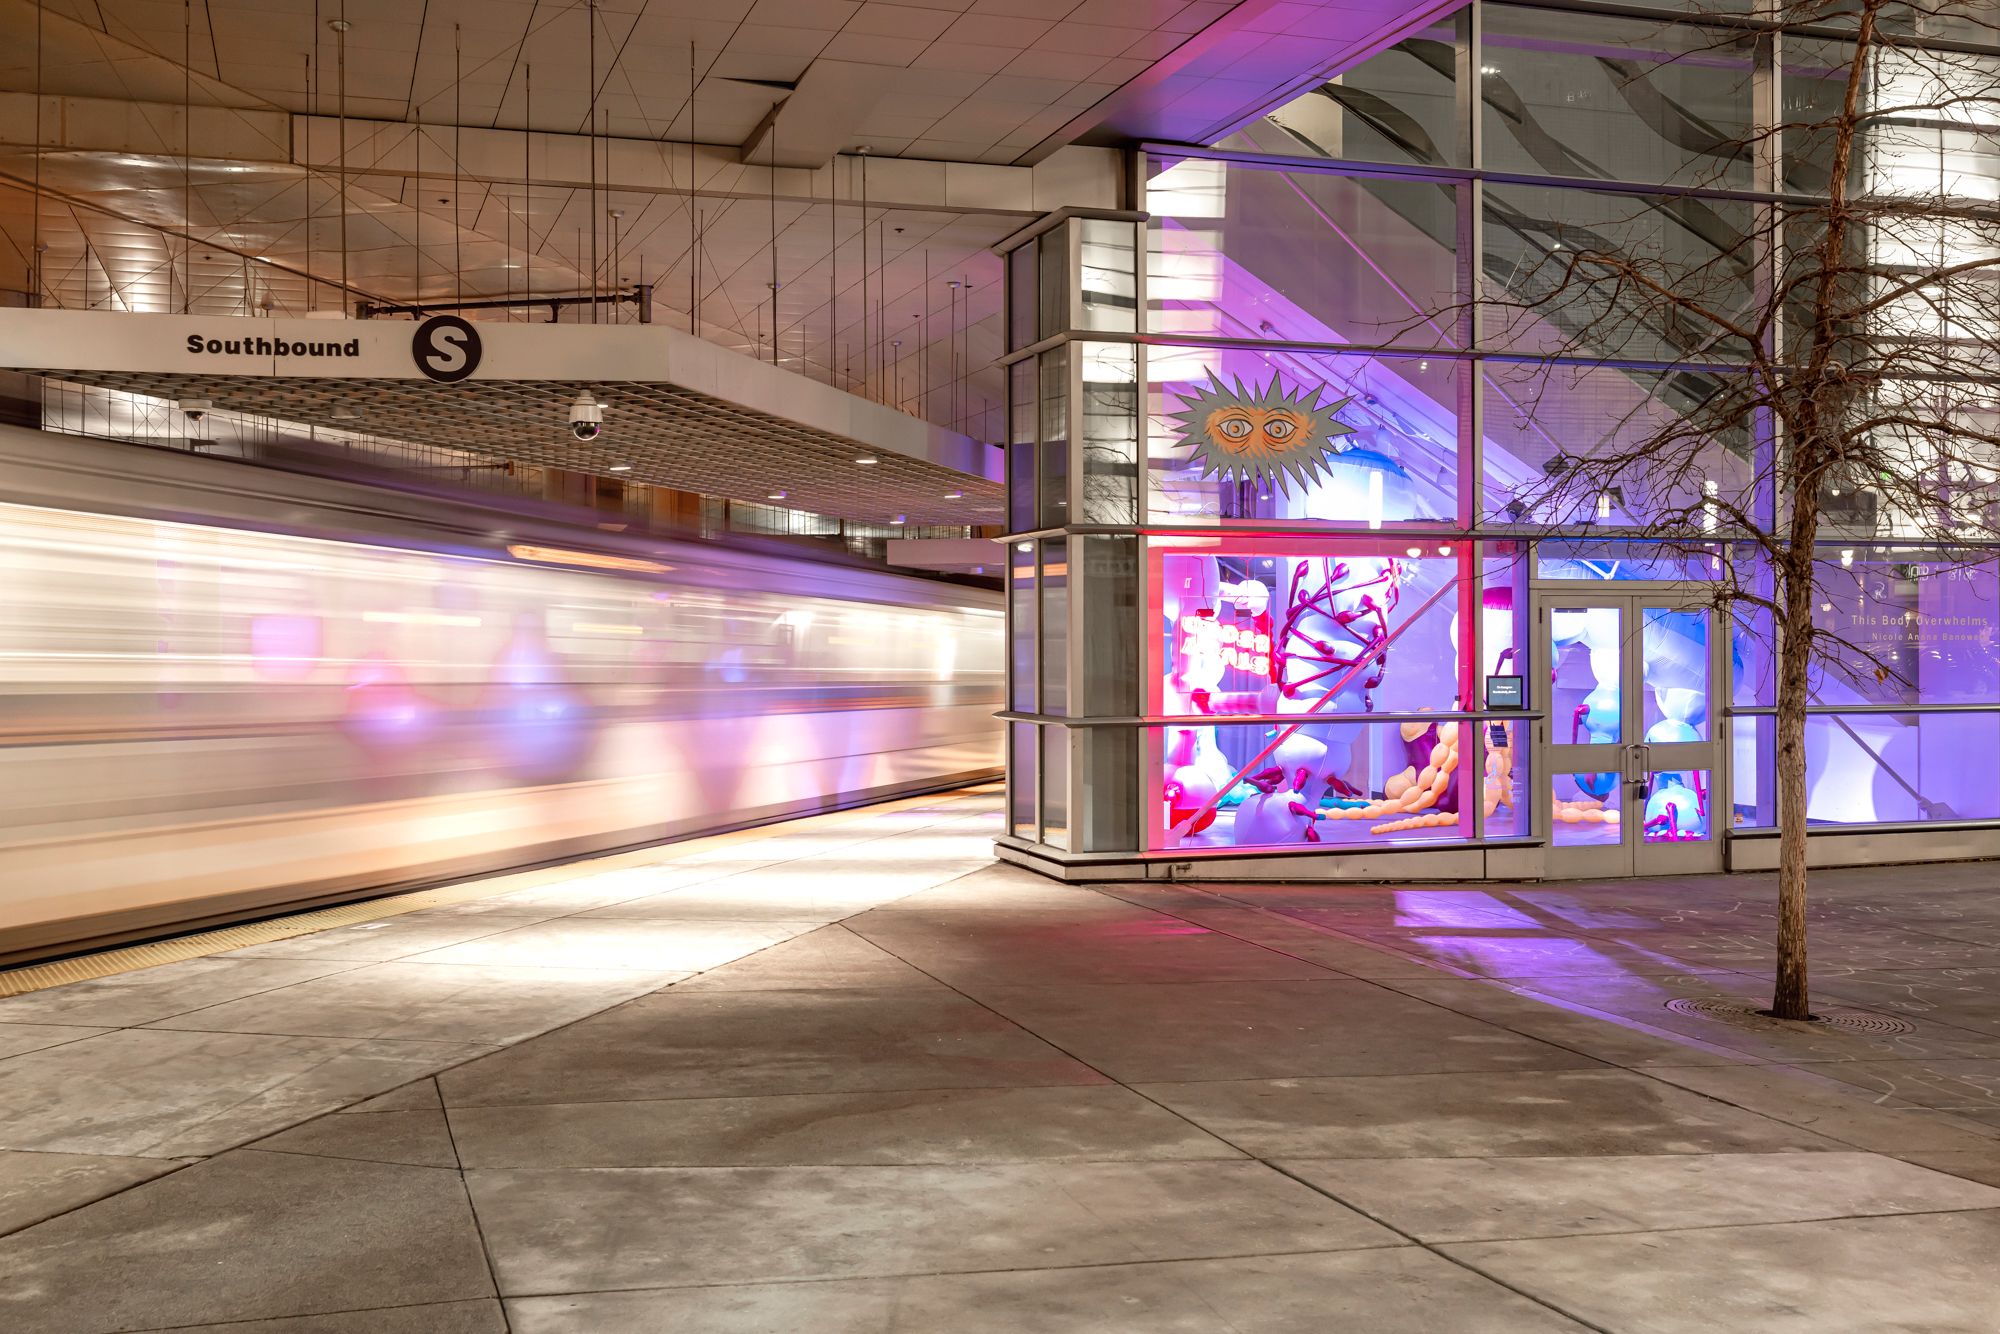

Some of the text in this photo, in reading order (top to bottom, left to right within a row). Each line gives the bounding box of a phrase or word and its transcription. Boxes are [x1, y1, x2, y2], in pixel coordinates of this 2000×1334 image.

[187, 325, 468, 372] Southbound S
[1851, 615, 1988, 627] This Body Overwhelms
[1872, 632, 1903, 641] Nicole
